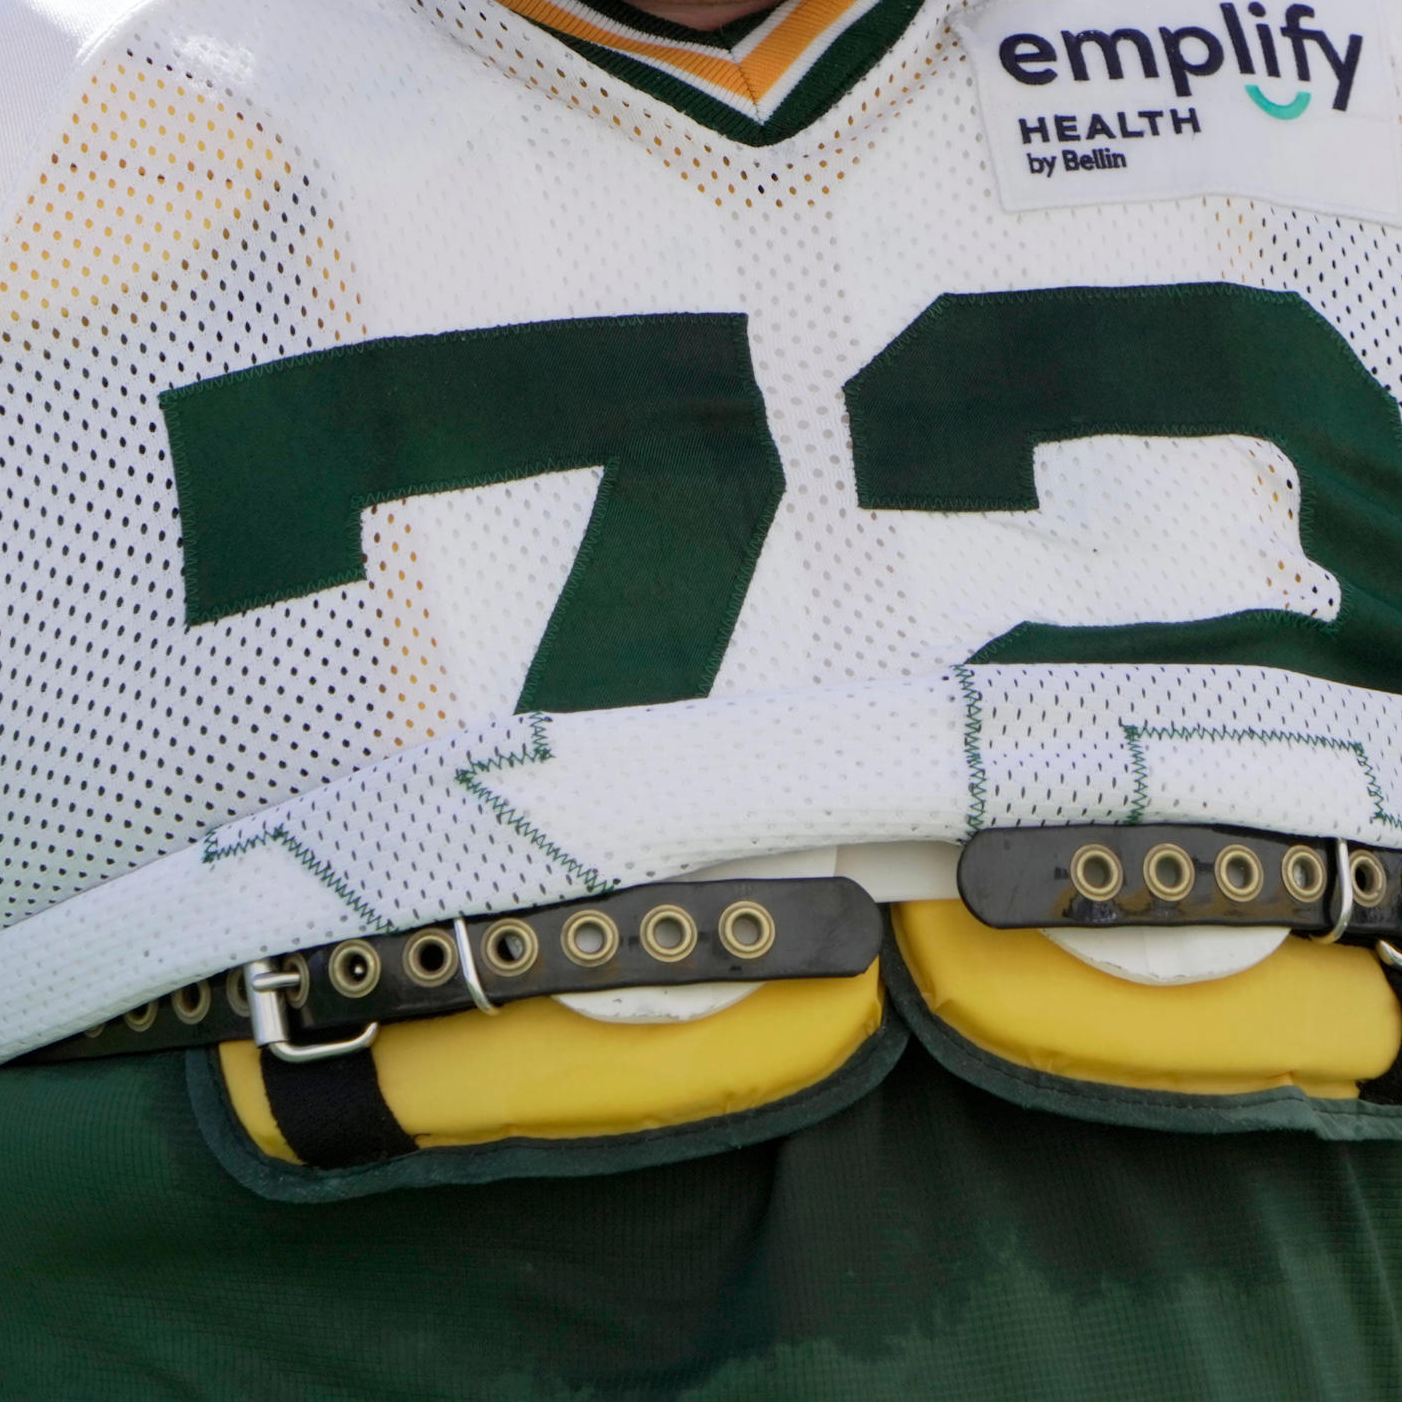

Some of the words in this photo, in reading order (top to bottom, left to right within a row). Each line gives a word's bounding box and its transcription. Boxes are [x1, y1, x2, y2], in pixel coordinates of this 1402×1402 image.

[998, 1, 1364, 112] emplify
[1018, 107, 1202, 145] HEALTH
[1026, 152, 1058, 178] by
[1061, 147, 1128, 172] Bellin
